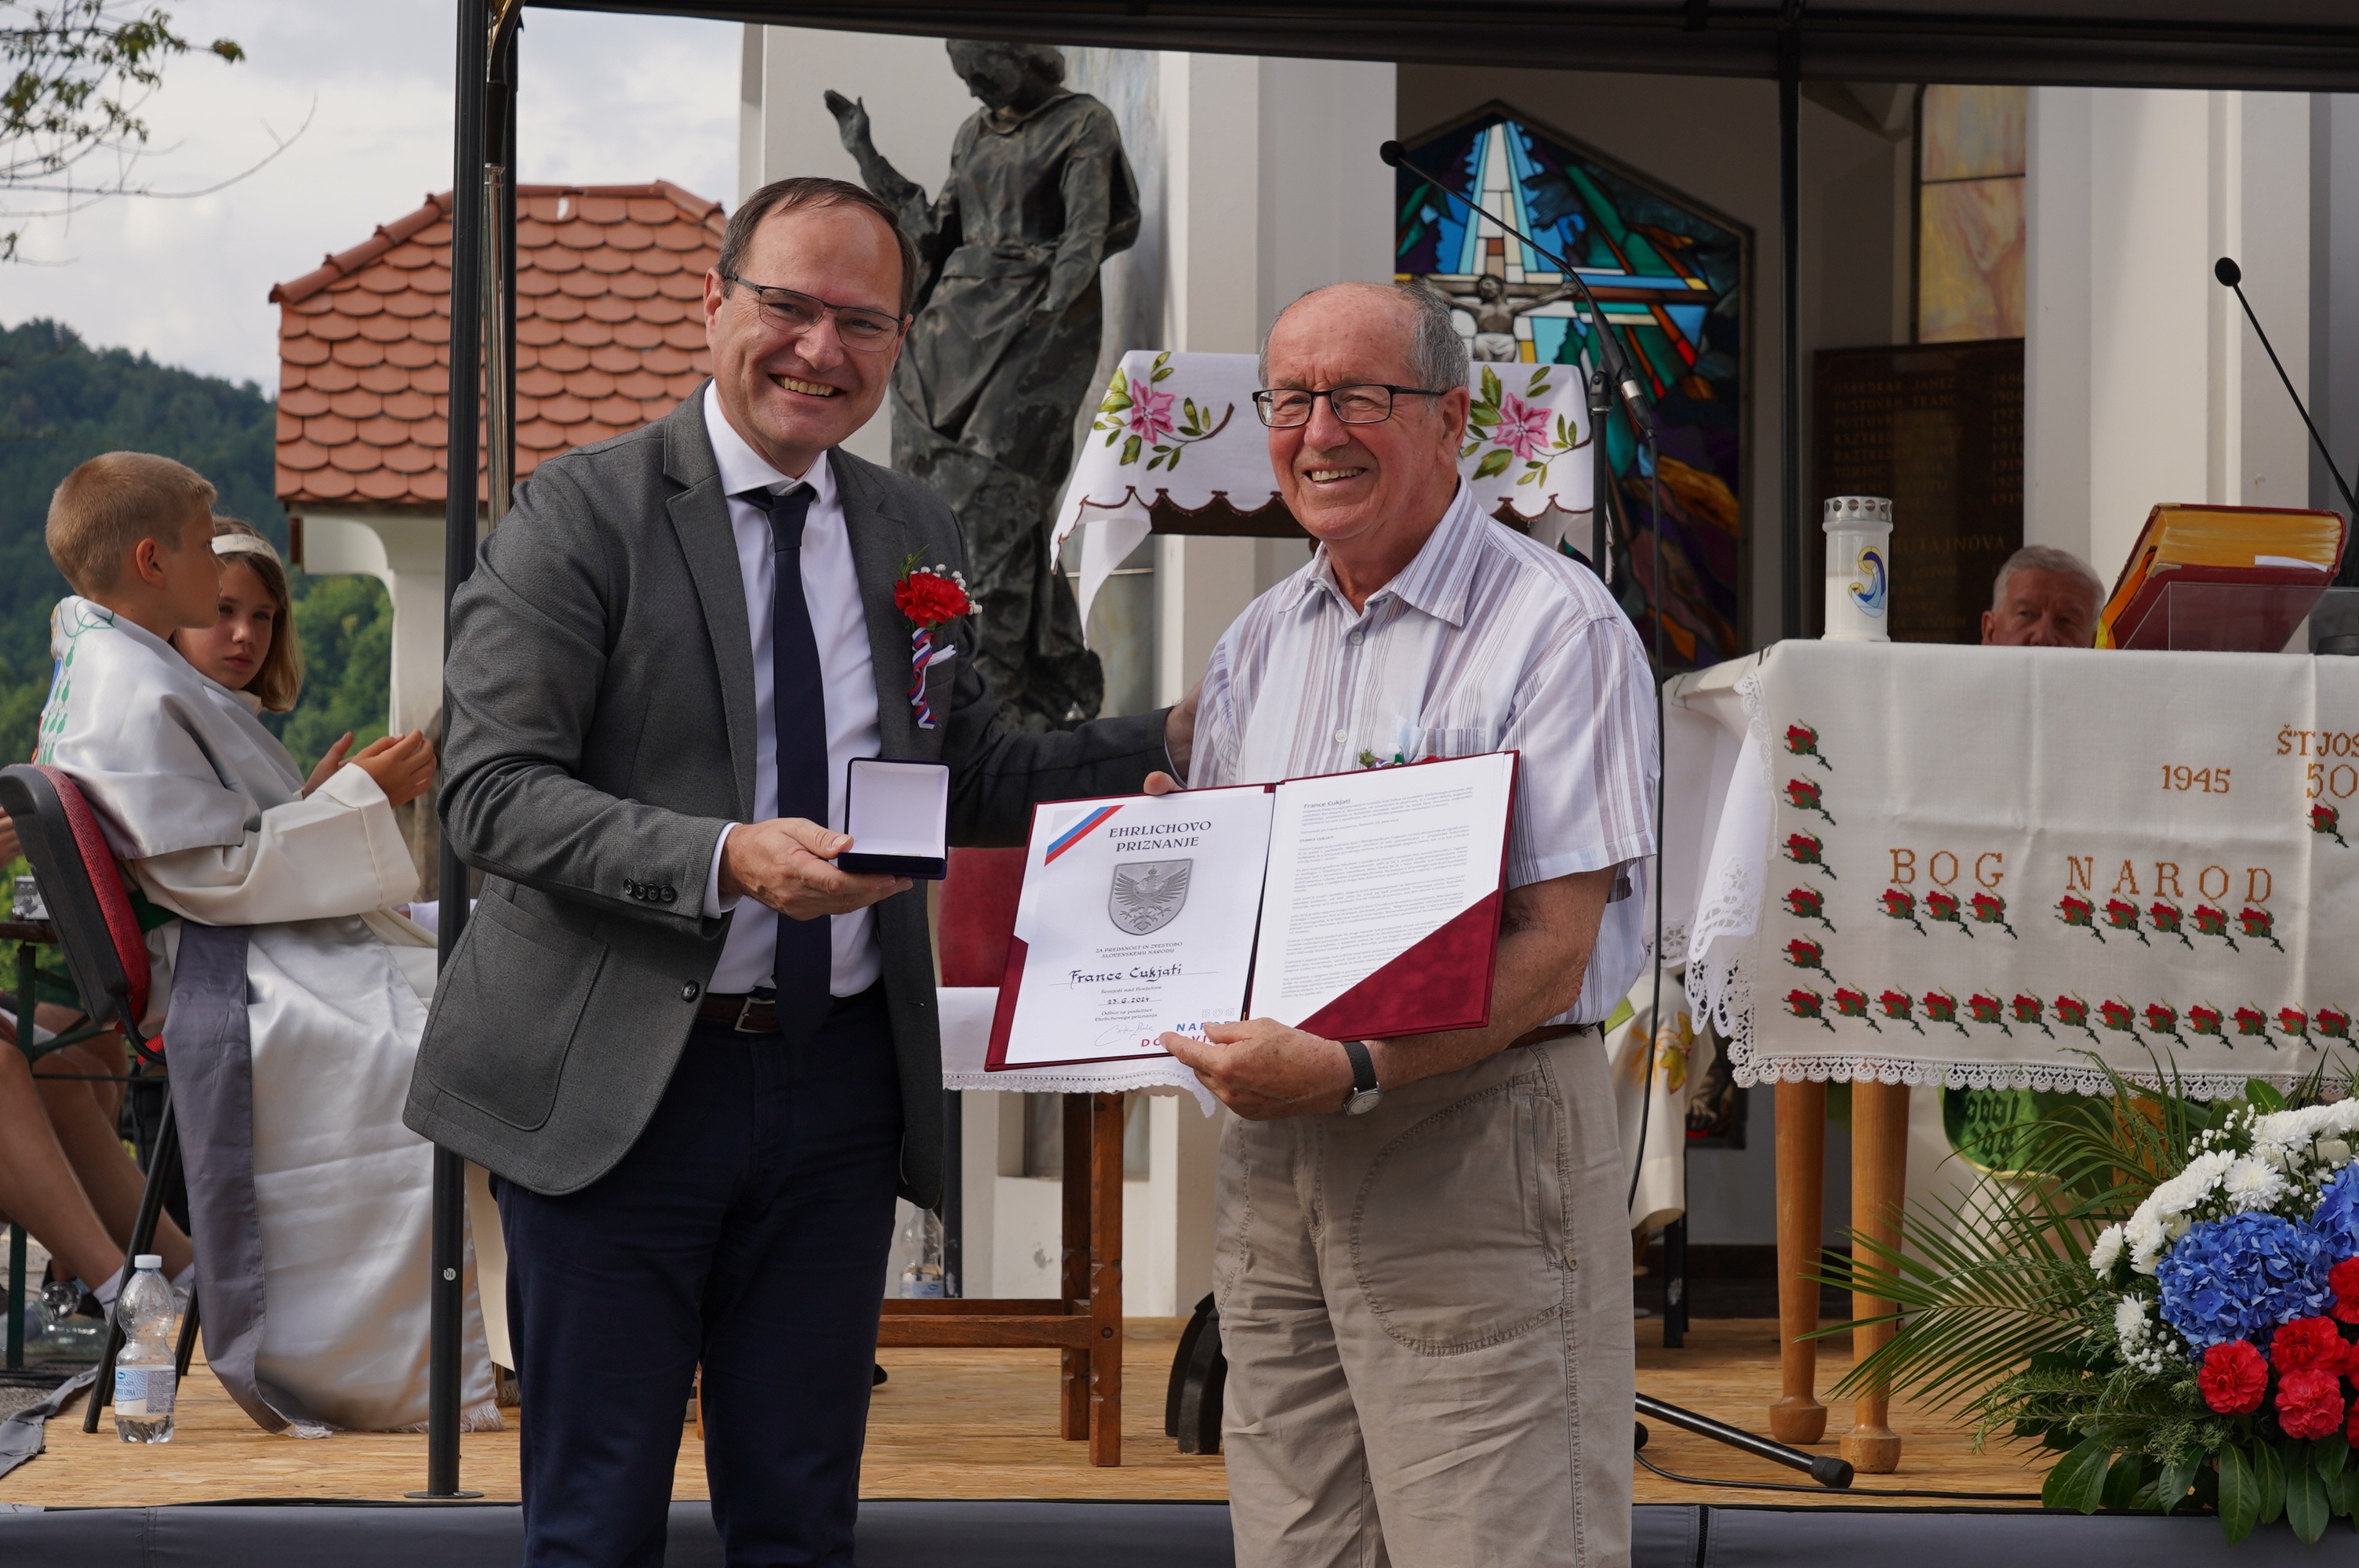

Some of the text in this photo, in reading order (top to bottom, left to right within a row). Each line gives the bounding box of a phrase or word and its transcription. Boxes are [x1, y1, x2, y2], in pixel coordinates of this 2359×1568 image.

[2161, 764, 2231, 793] 1945
[2306, 763, 2358, 798] 50
[1108, 821, 1212, 838] EHRLICHOVO
[1115, 837, 1199, 852] PRIZNANJE
[1890, 848, 2273, 902] BOG NAROD
[1068, 969, 1122, 989] France
[1202, 1007, 1235, 1018] BOG
